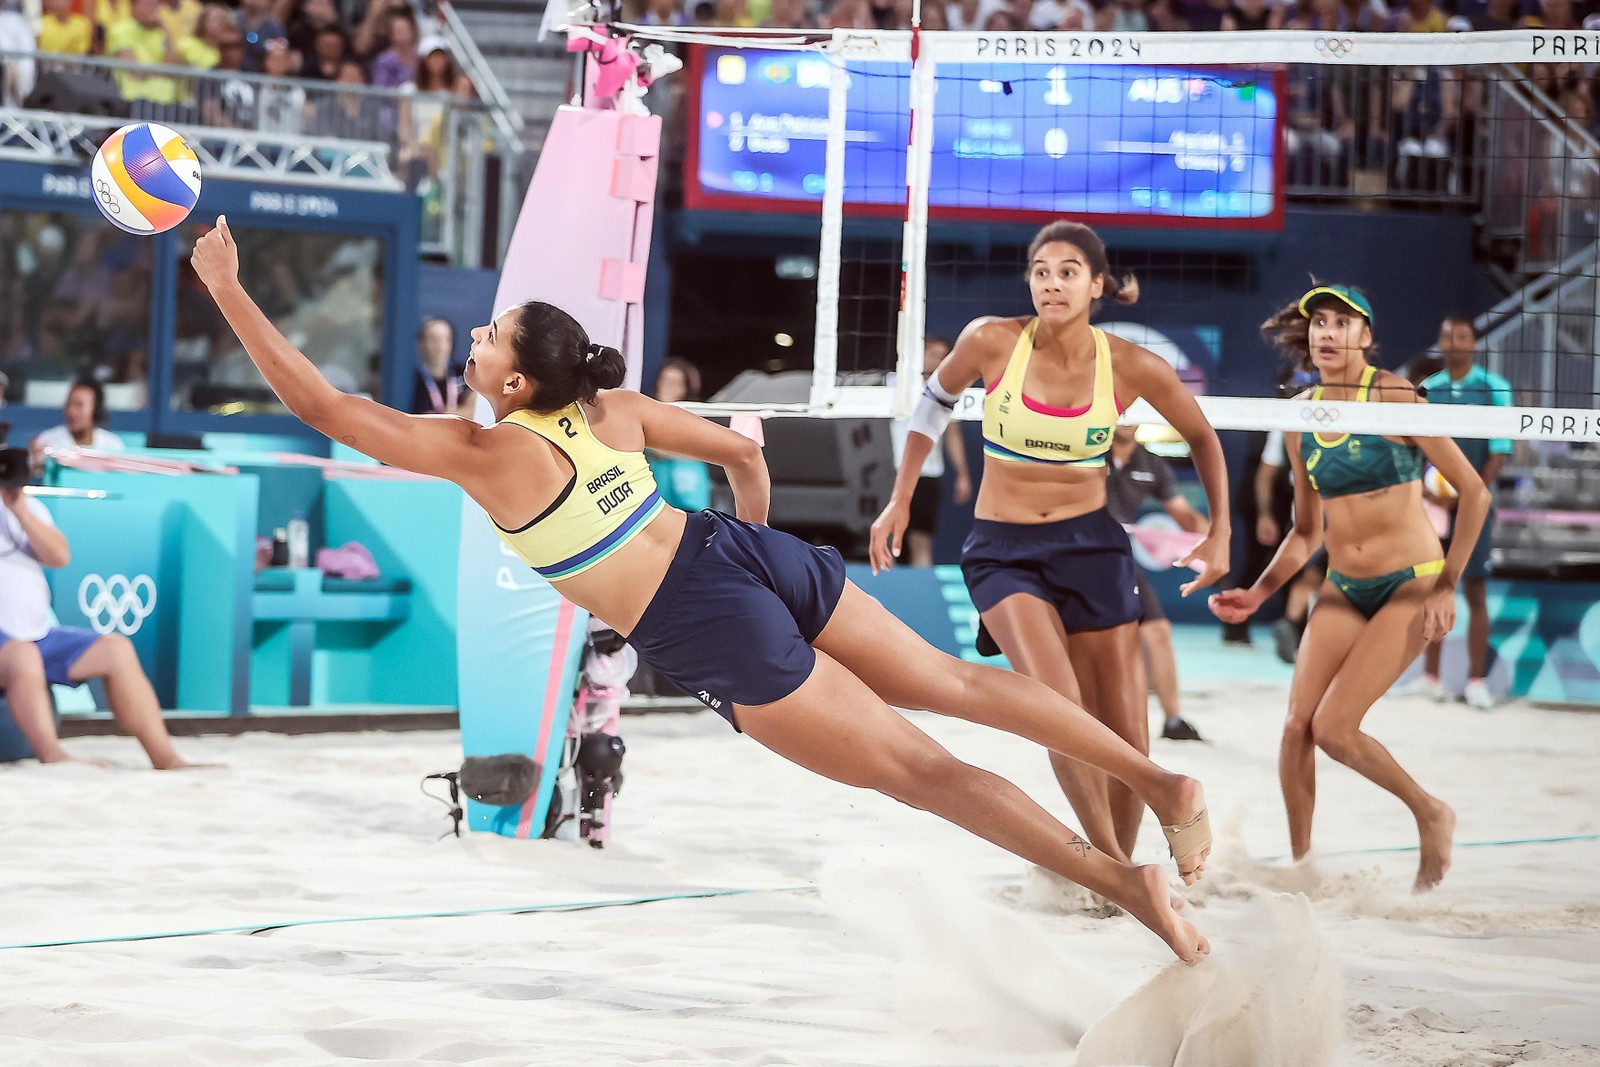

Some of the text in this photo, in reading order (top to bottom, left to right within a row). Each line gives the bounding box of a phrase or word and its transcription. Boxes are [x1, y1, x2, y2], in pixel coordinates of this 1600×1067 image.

[1069, 37, 1141, 57] 2024
[558, 417, 578, 438] 2
[1025, 438, 1071, 452] BRASIL
[586, 465, 625, 495] BRASIL
[596, 481, 634, 515] DUDA
